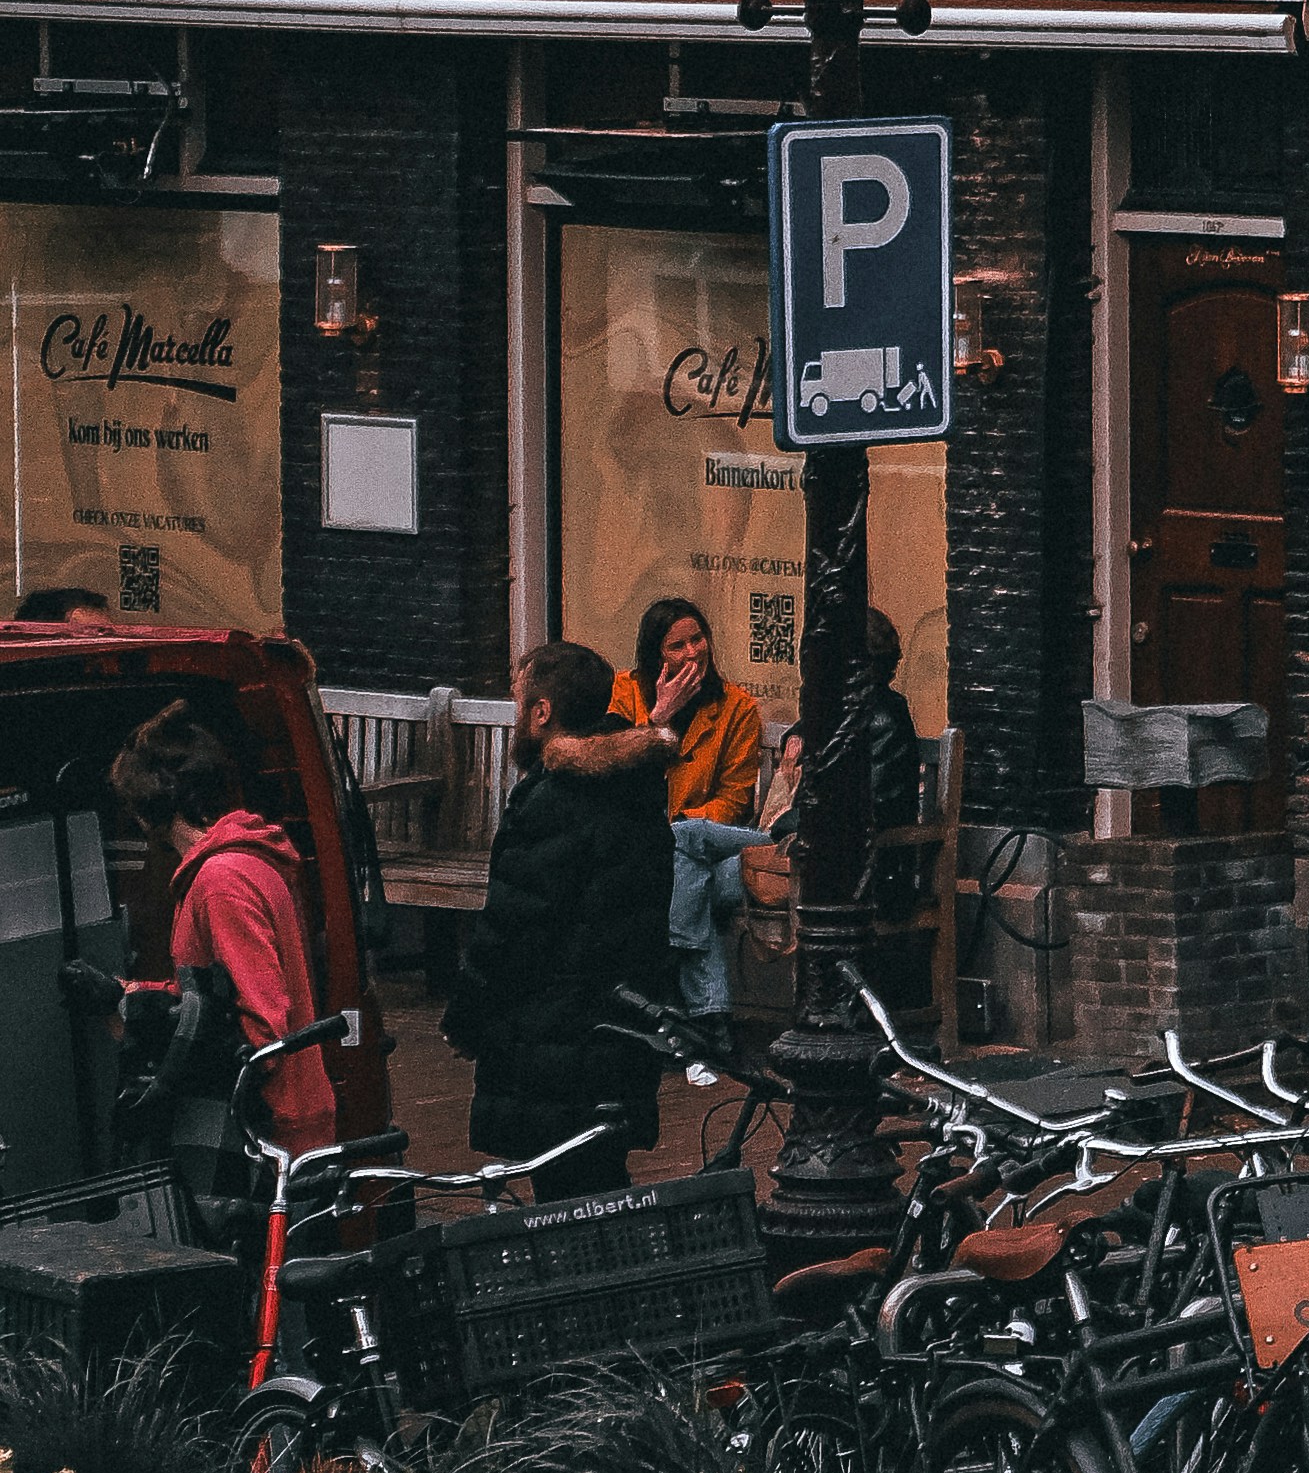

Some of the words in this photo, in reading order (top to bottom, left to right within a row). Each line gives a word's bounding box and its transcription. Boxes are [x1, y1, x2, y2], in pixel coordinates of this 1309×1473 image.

[820, 154, 910, 309] P
[41, 313, 109, 380] Café
[106, 303, 234, 391] Marcella
[663, 346, 740, 417] Café
[125, 427, 151, 448] ons
[154, 423, 209, 453] werken
[705, 456, 796, 491] Binnenkort
[523, 1189, 658, 1230] www.albert.nl
